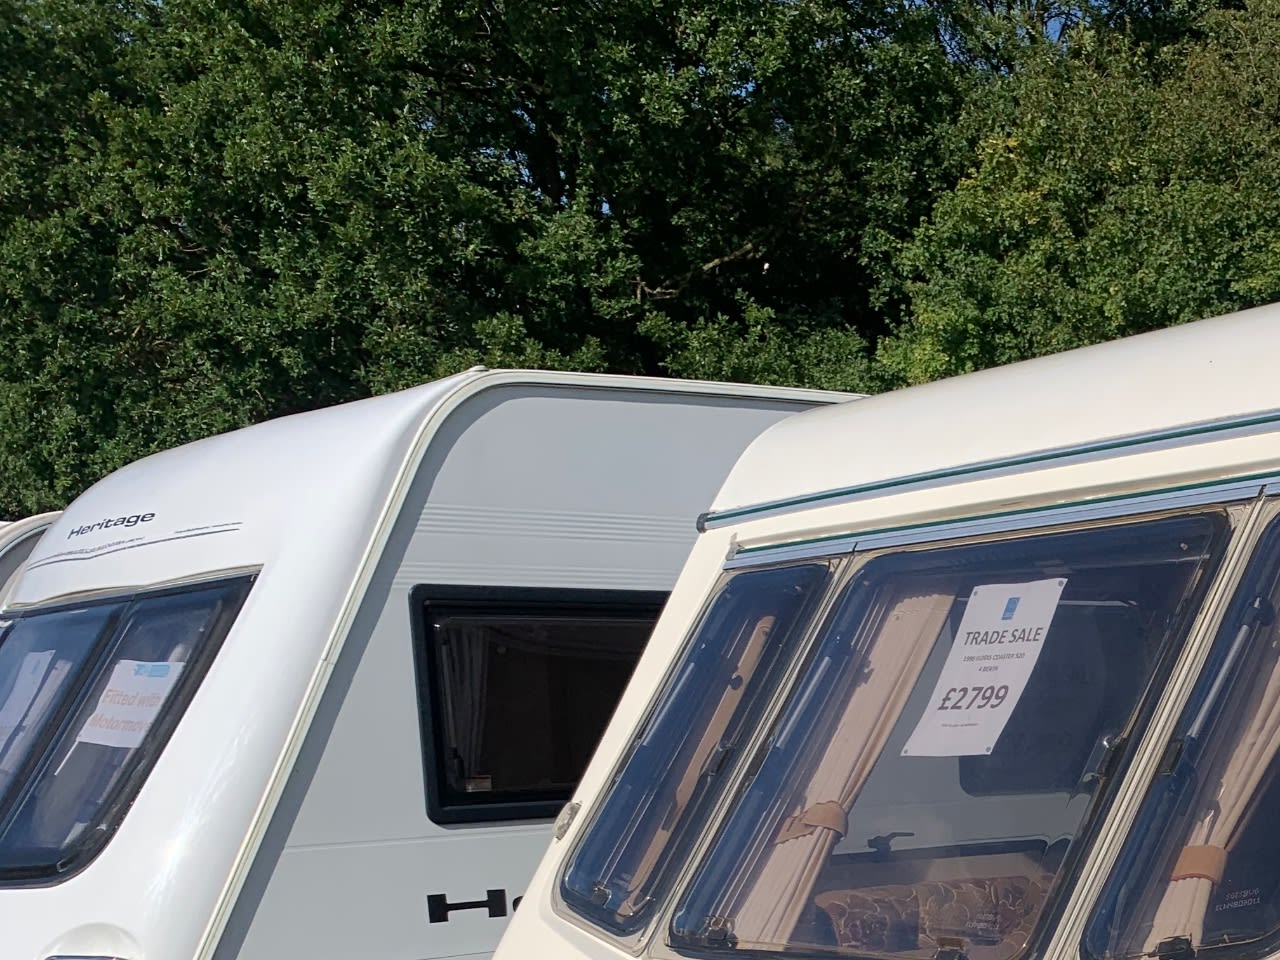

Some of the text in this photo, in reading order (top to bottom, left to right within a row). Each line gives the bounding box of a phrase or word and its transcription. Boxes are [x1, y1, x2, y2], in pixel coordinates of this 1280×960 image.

[67, 512, 156, 539] Heritage
[964, 627, 1043, 646] TRADE SALE
[102, 689, 139, 706] Fitted
[937, 685, 1010, 711] £2799
